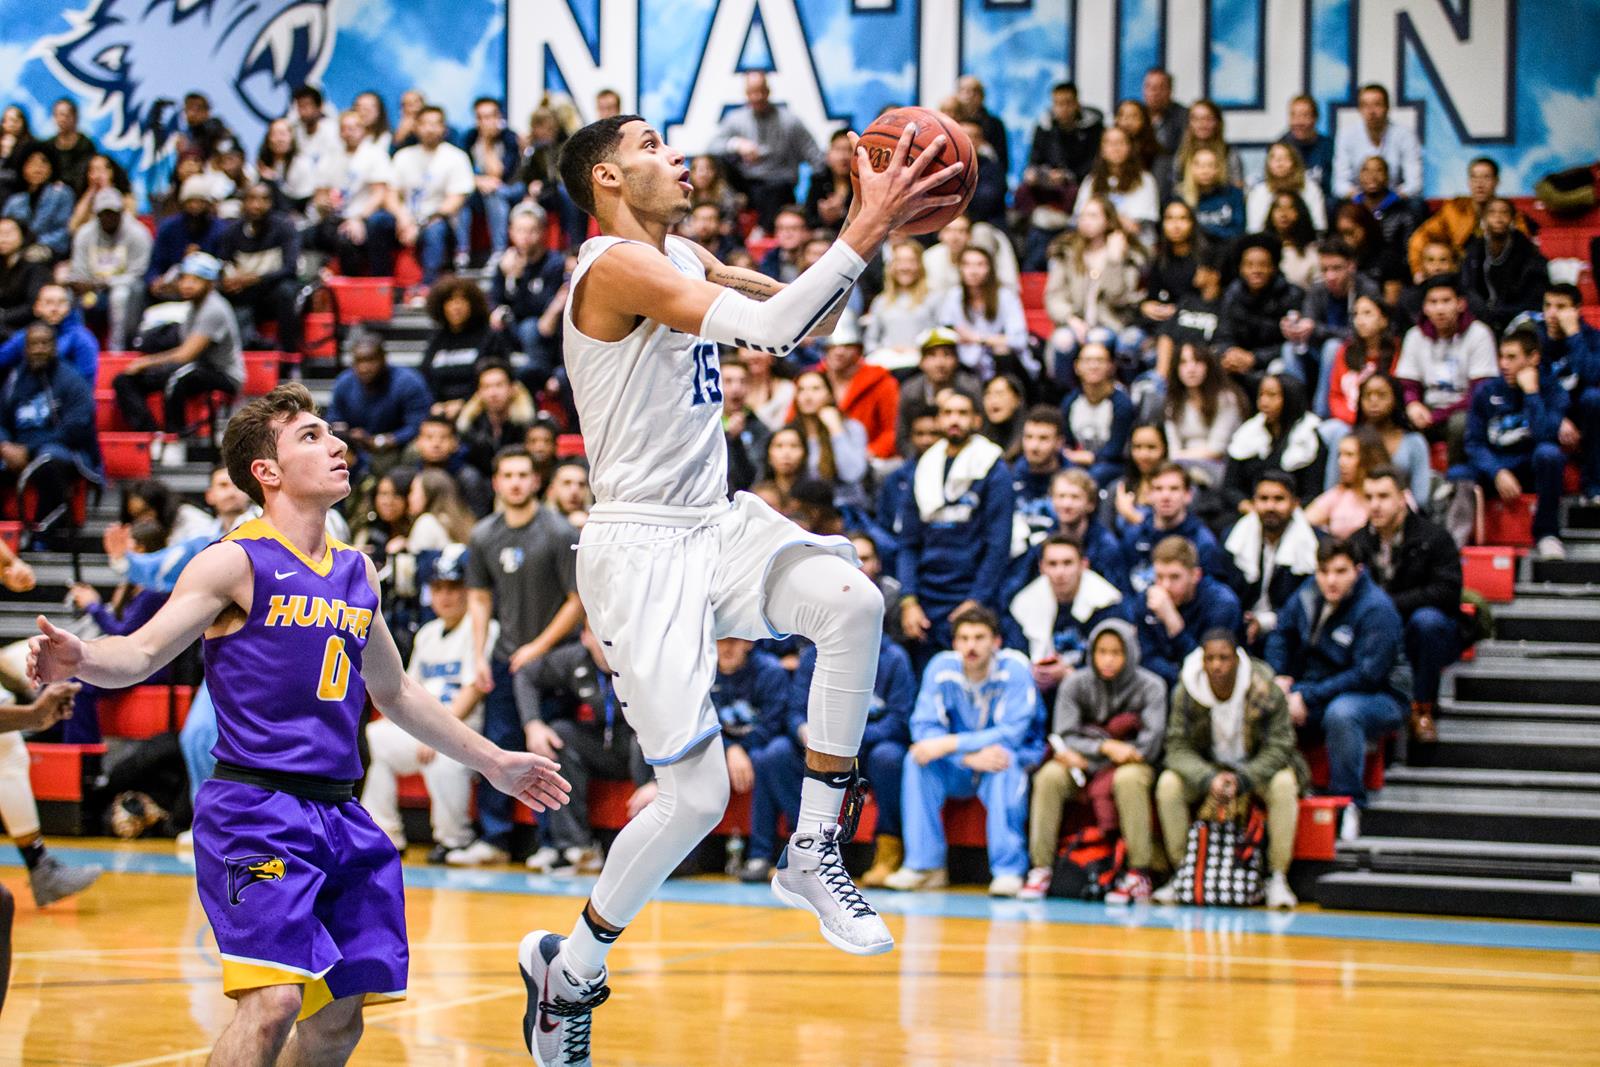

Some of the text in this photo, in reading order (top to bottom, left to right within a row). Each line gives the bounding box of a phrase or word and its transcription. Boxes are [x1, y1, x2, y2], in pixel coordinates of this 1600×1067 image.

[693, 343, 722, 405] 15
[264, 595, 373, 640] HUNTER
[316, 635, 351, 702] 0
